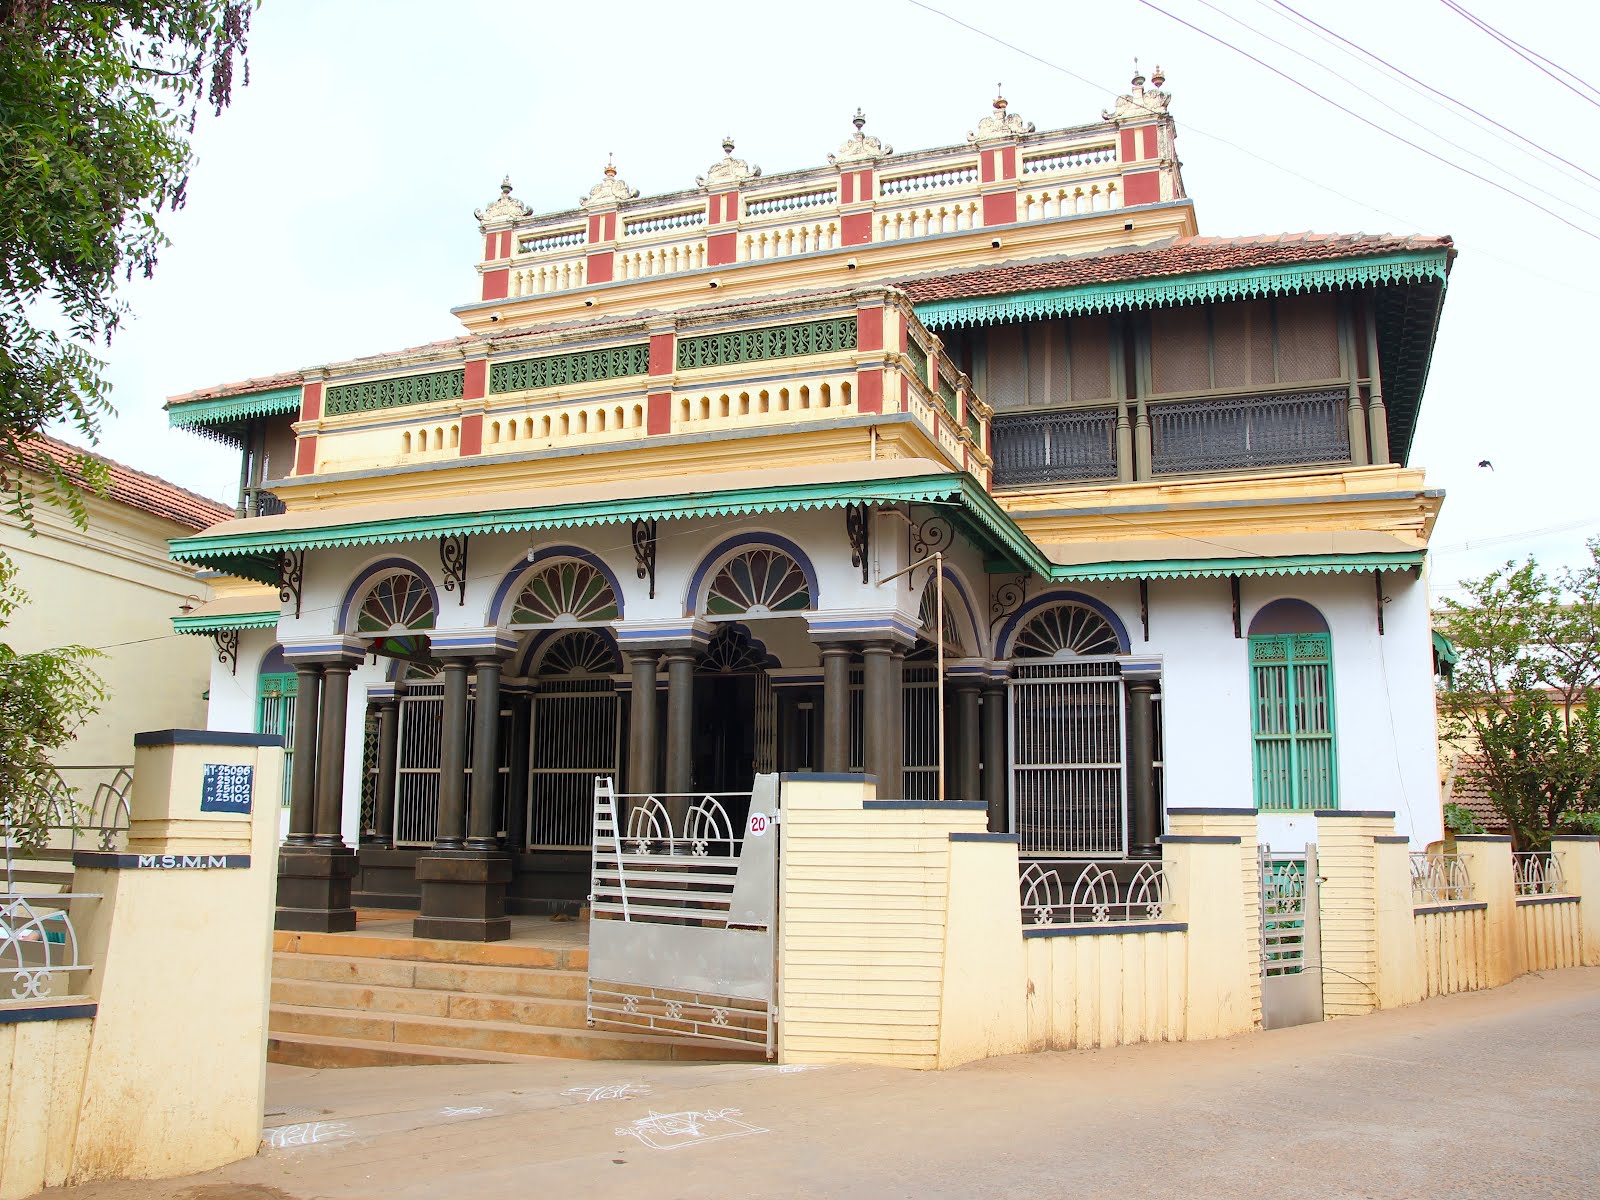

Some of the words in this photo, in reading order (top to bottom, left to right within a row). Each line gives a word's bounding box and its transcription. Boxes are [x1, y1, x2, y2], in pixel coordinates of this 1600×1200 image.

[216, 775, 249, 785] 25101
[215, 784, 250, 794] 25102
[215, 792, 250, 804] 25103
[751, 817, 765, 832] 20
[138, 855, 227, 868] M.S.M.M
